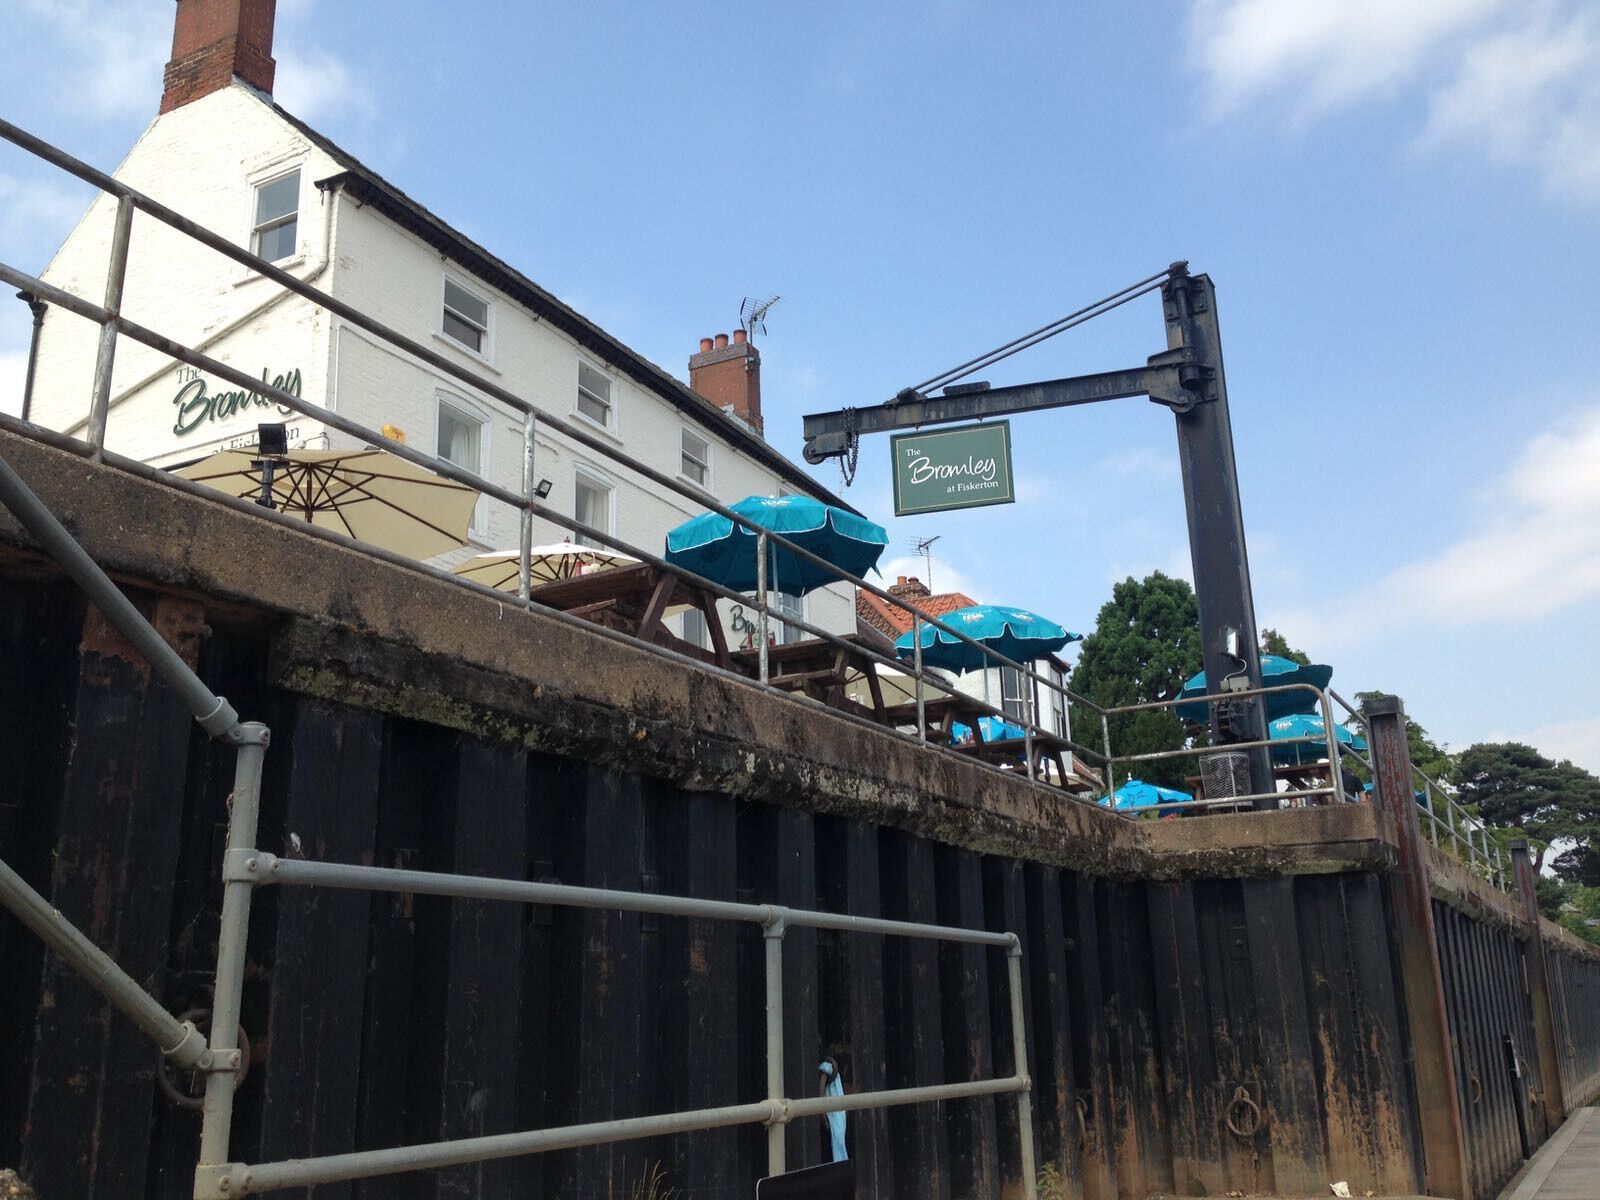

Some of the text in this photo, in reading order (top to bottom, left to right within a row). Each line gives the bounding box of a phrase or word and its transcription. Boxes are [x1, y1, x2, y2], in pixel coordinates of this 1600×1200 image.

[176, 366, 201, 384] The
[905, 448, 921, 457] The
[908, 455, 996, 485] Bromley
[946, 479, 999, 493] at Fiskerton
